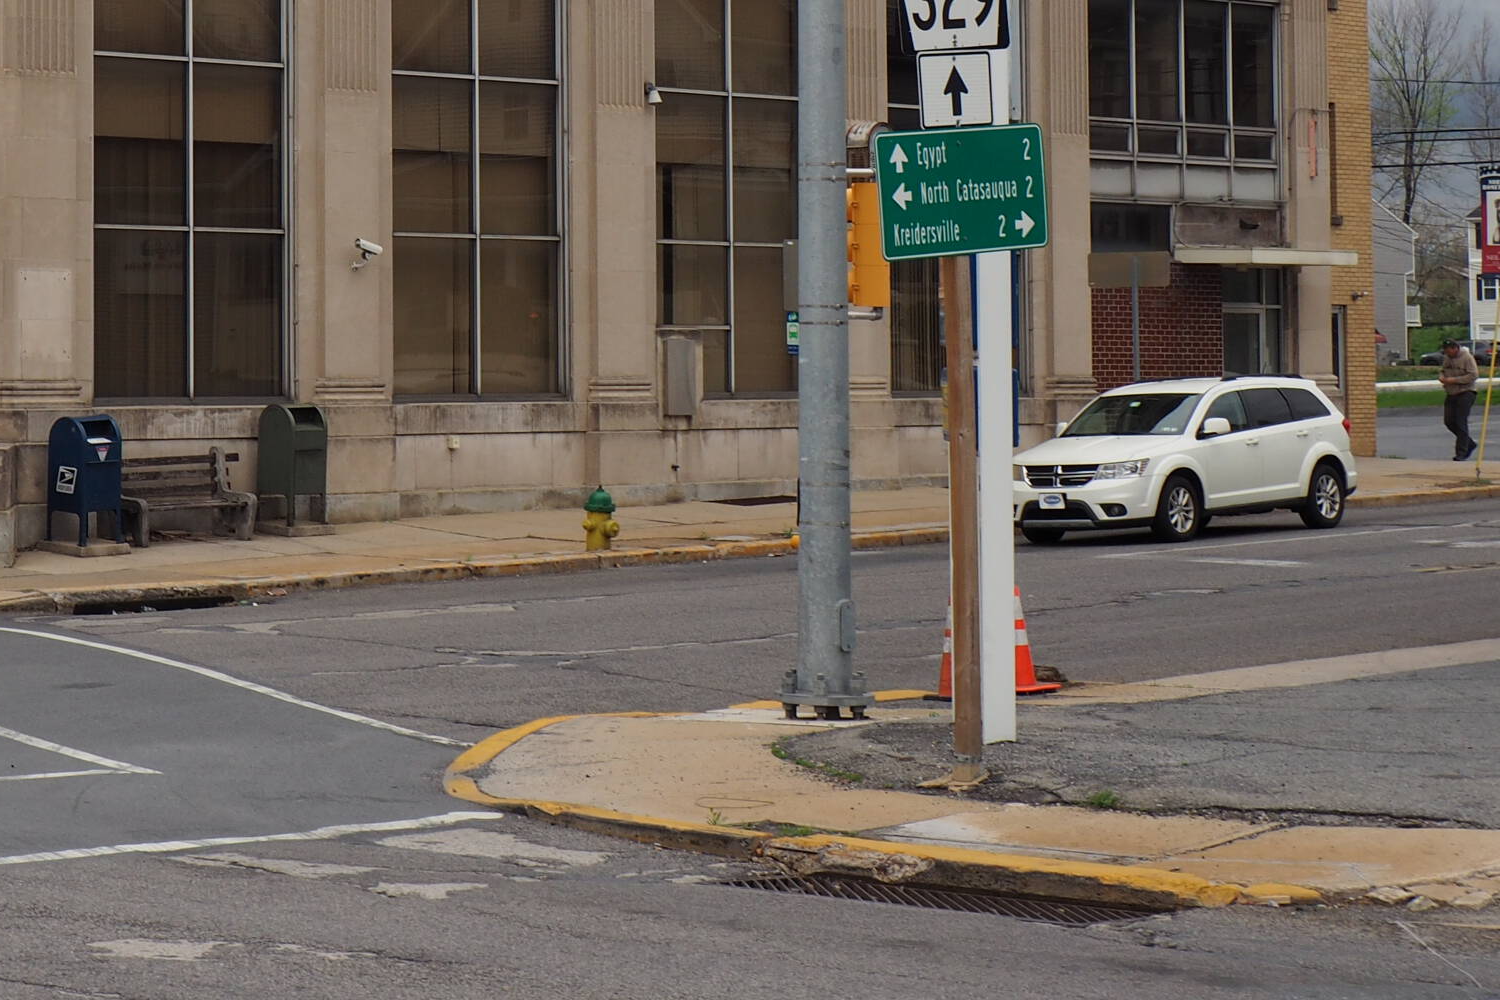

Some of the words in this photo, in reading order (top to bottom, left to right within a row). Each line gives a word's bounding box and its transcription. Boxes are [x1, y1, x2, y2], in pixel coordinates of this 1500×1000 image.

[916, 140, 947, 170] Egypt
[1022, 137, 1031, 161] 2
[920, 180, 950, 204] North
[956, 178, 1017, 201] Catasauqua
[1025, 175, 1034, 198] 2
[893, 219, 960, 247] Kreidersville
[998, 214, 1007, 238] 2
